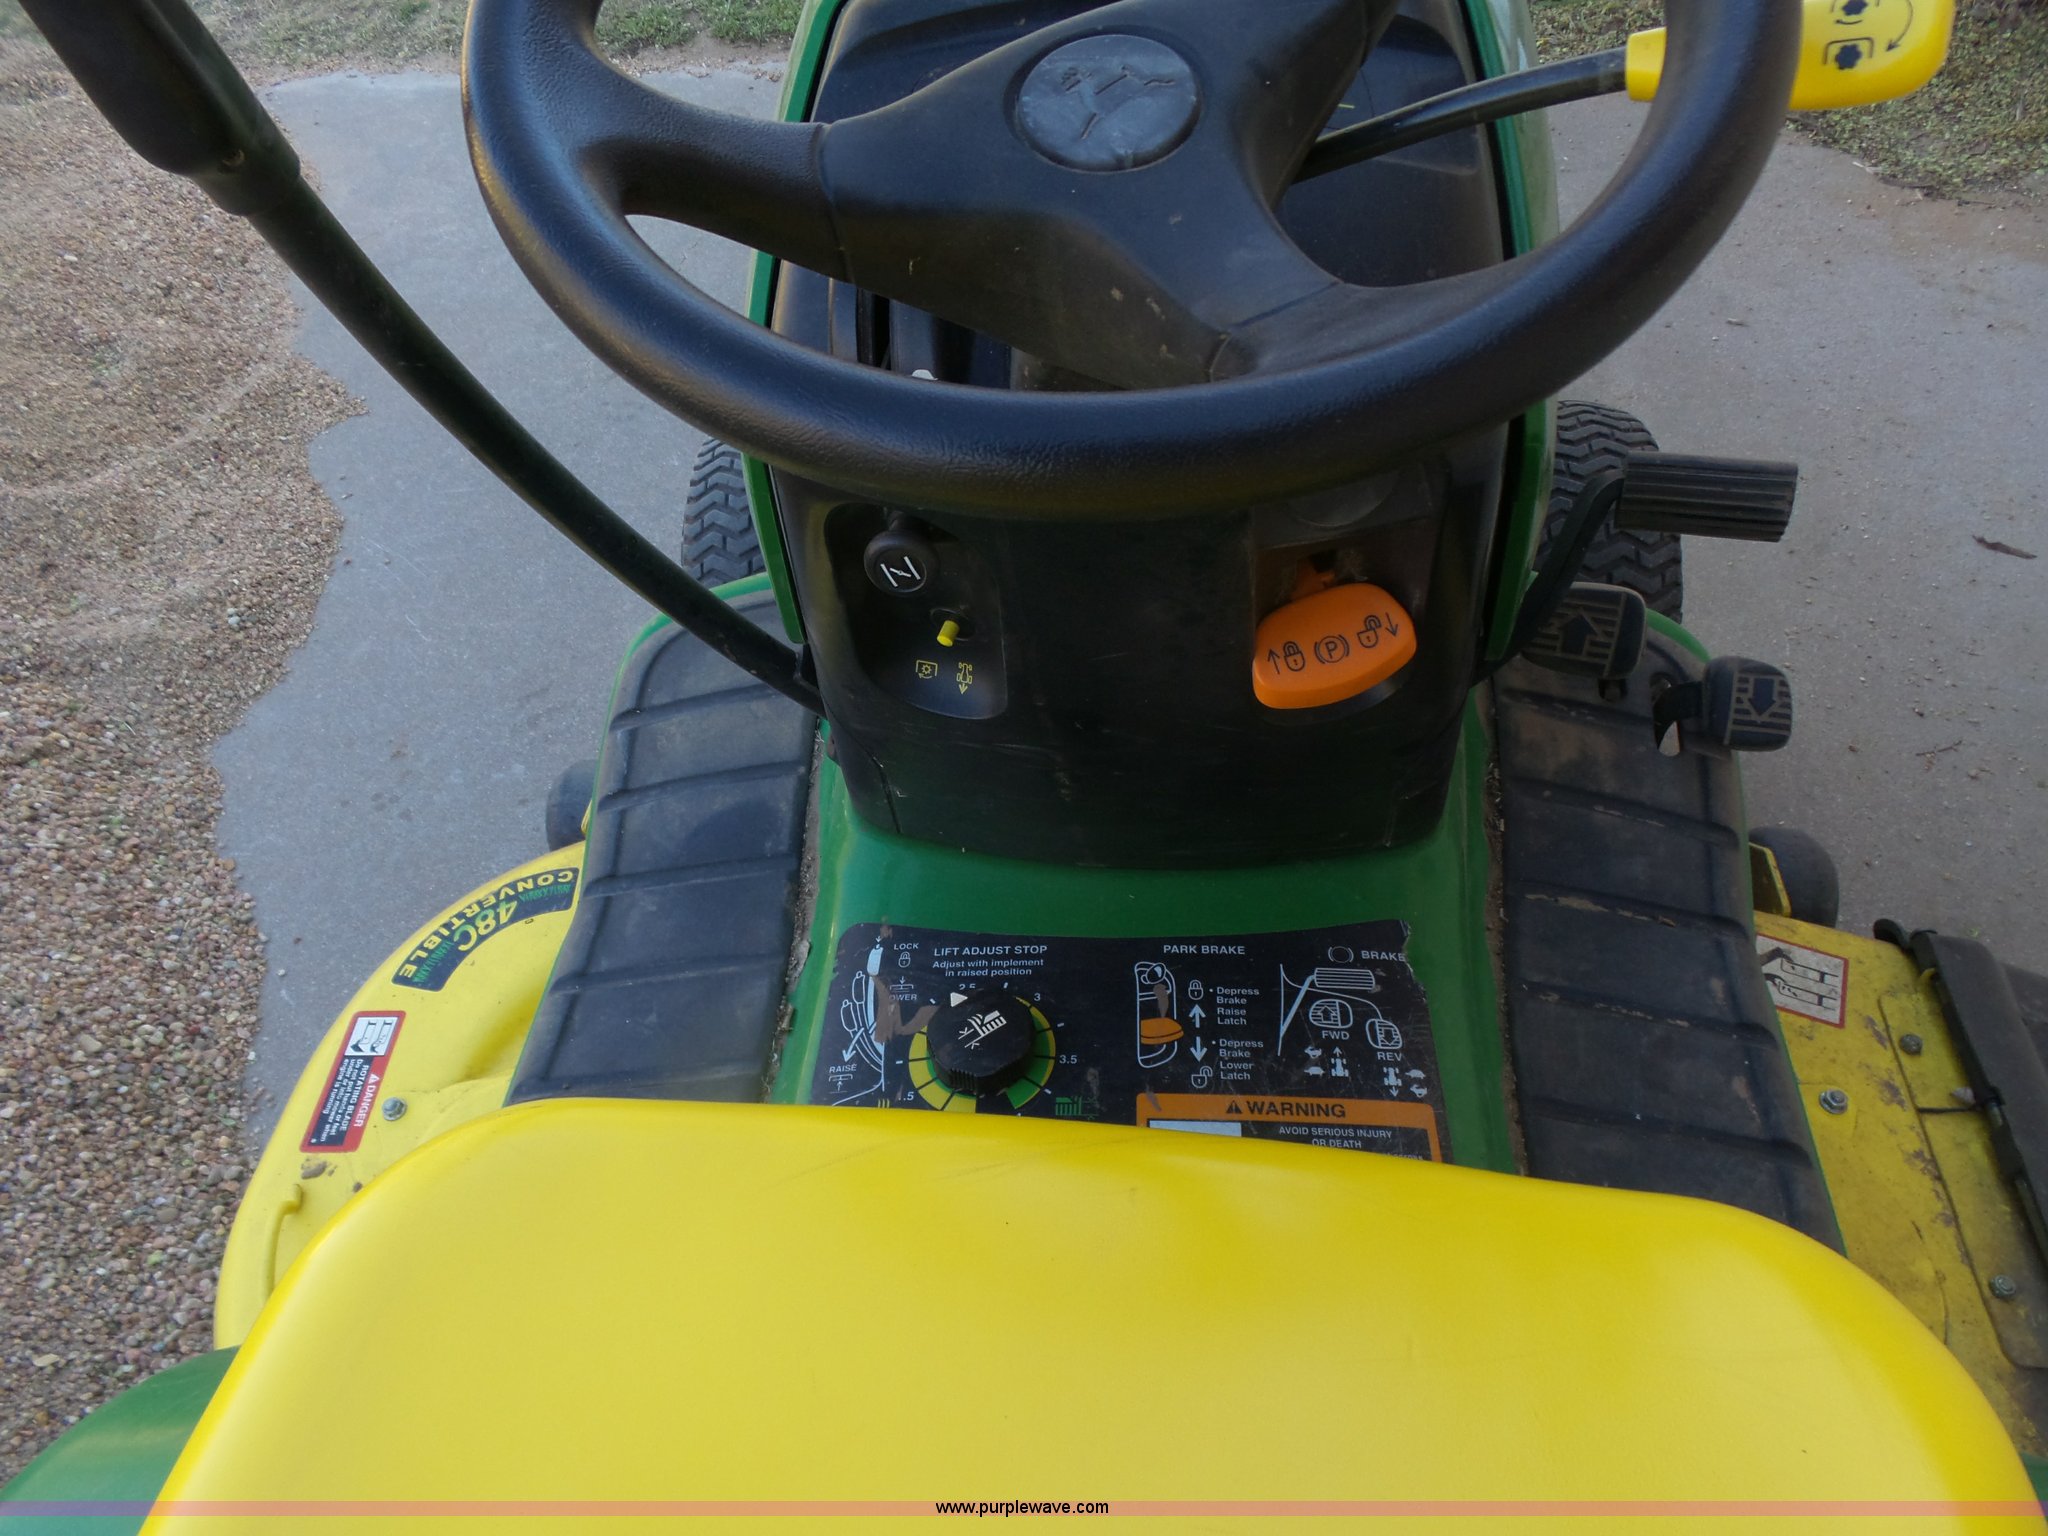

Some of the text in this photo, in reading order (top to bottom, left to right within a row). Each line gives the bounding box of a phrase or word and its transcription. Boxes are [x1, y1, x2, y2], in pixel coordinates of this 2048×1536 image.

[399, 870, 574, 978] CONVERTIBLE
[453, 900, 518, 951] 48C
[893, 942, 919, 950] LOCK
[934, 945, 1048, 957] LIFT ADJUST STOP
[1163, 944, 1246, 955] PARK BRAKE
[1361, 950, 1406, 962] BRAKE
[932, 958, 1044, 969] Adjust with implement
[945, 968, 1032, 977] in raised position
[1216, 986, 1260, 996] Depress
[1033, 992, 1041, 1001] 3
[1216, 996, 1247, 1005] Brake
[1216, 1007, 1247, 1016] Raise
[1217, 1017, 1247, 1025] Latch
[1322, 1030, 1349, 1040] FWD
[1219, 1038, 1264, 1048] Depress
[1219, 1048, 1251, 1058] Brake
[1377, 1051, 1403, 1061] REV
[1059, 1054, 1078, 1064] 3.5
[337, 1058, 349, 1080] engine
[829, 1064, 858, 1073] RAISE
[1220, 1061, 1254, 1070] Lower
[1220, 1071, 1251, 1080] Latch
[322, 1088, 338, 1114] running
[339, 1064, 370, 1131] ROTATING BLADE
[328, 1100, 340, 1122] mower
[353, 1085, 377, 1127] DANGER
[1246, 1100, 1346, 1118] WARNING
[320, 1124, 331, 1141] when
[1279, 1126, 1392, 1139] AVOID SERIOUS INJURY
[1329, 1139, 1362, 1149] DEATH
